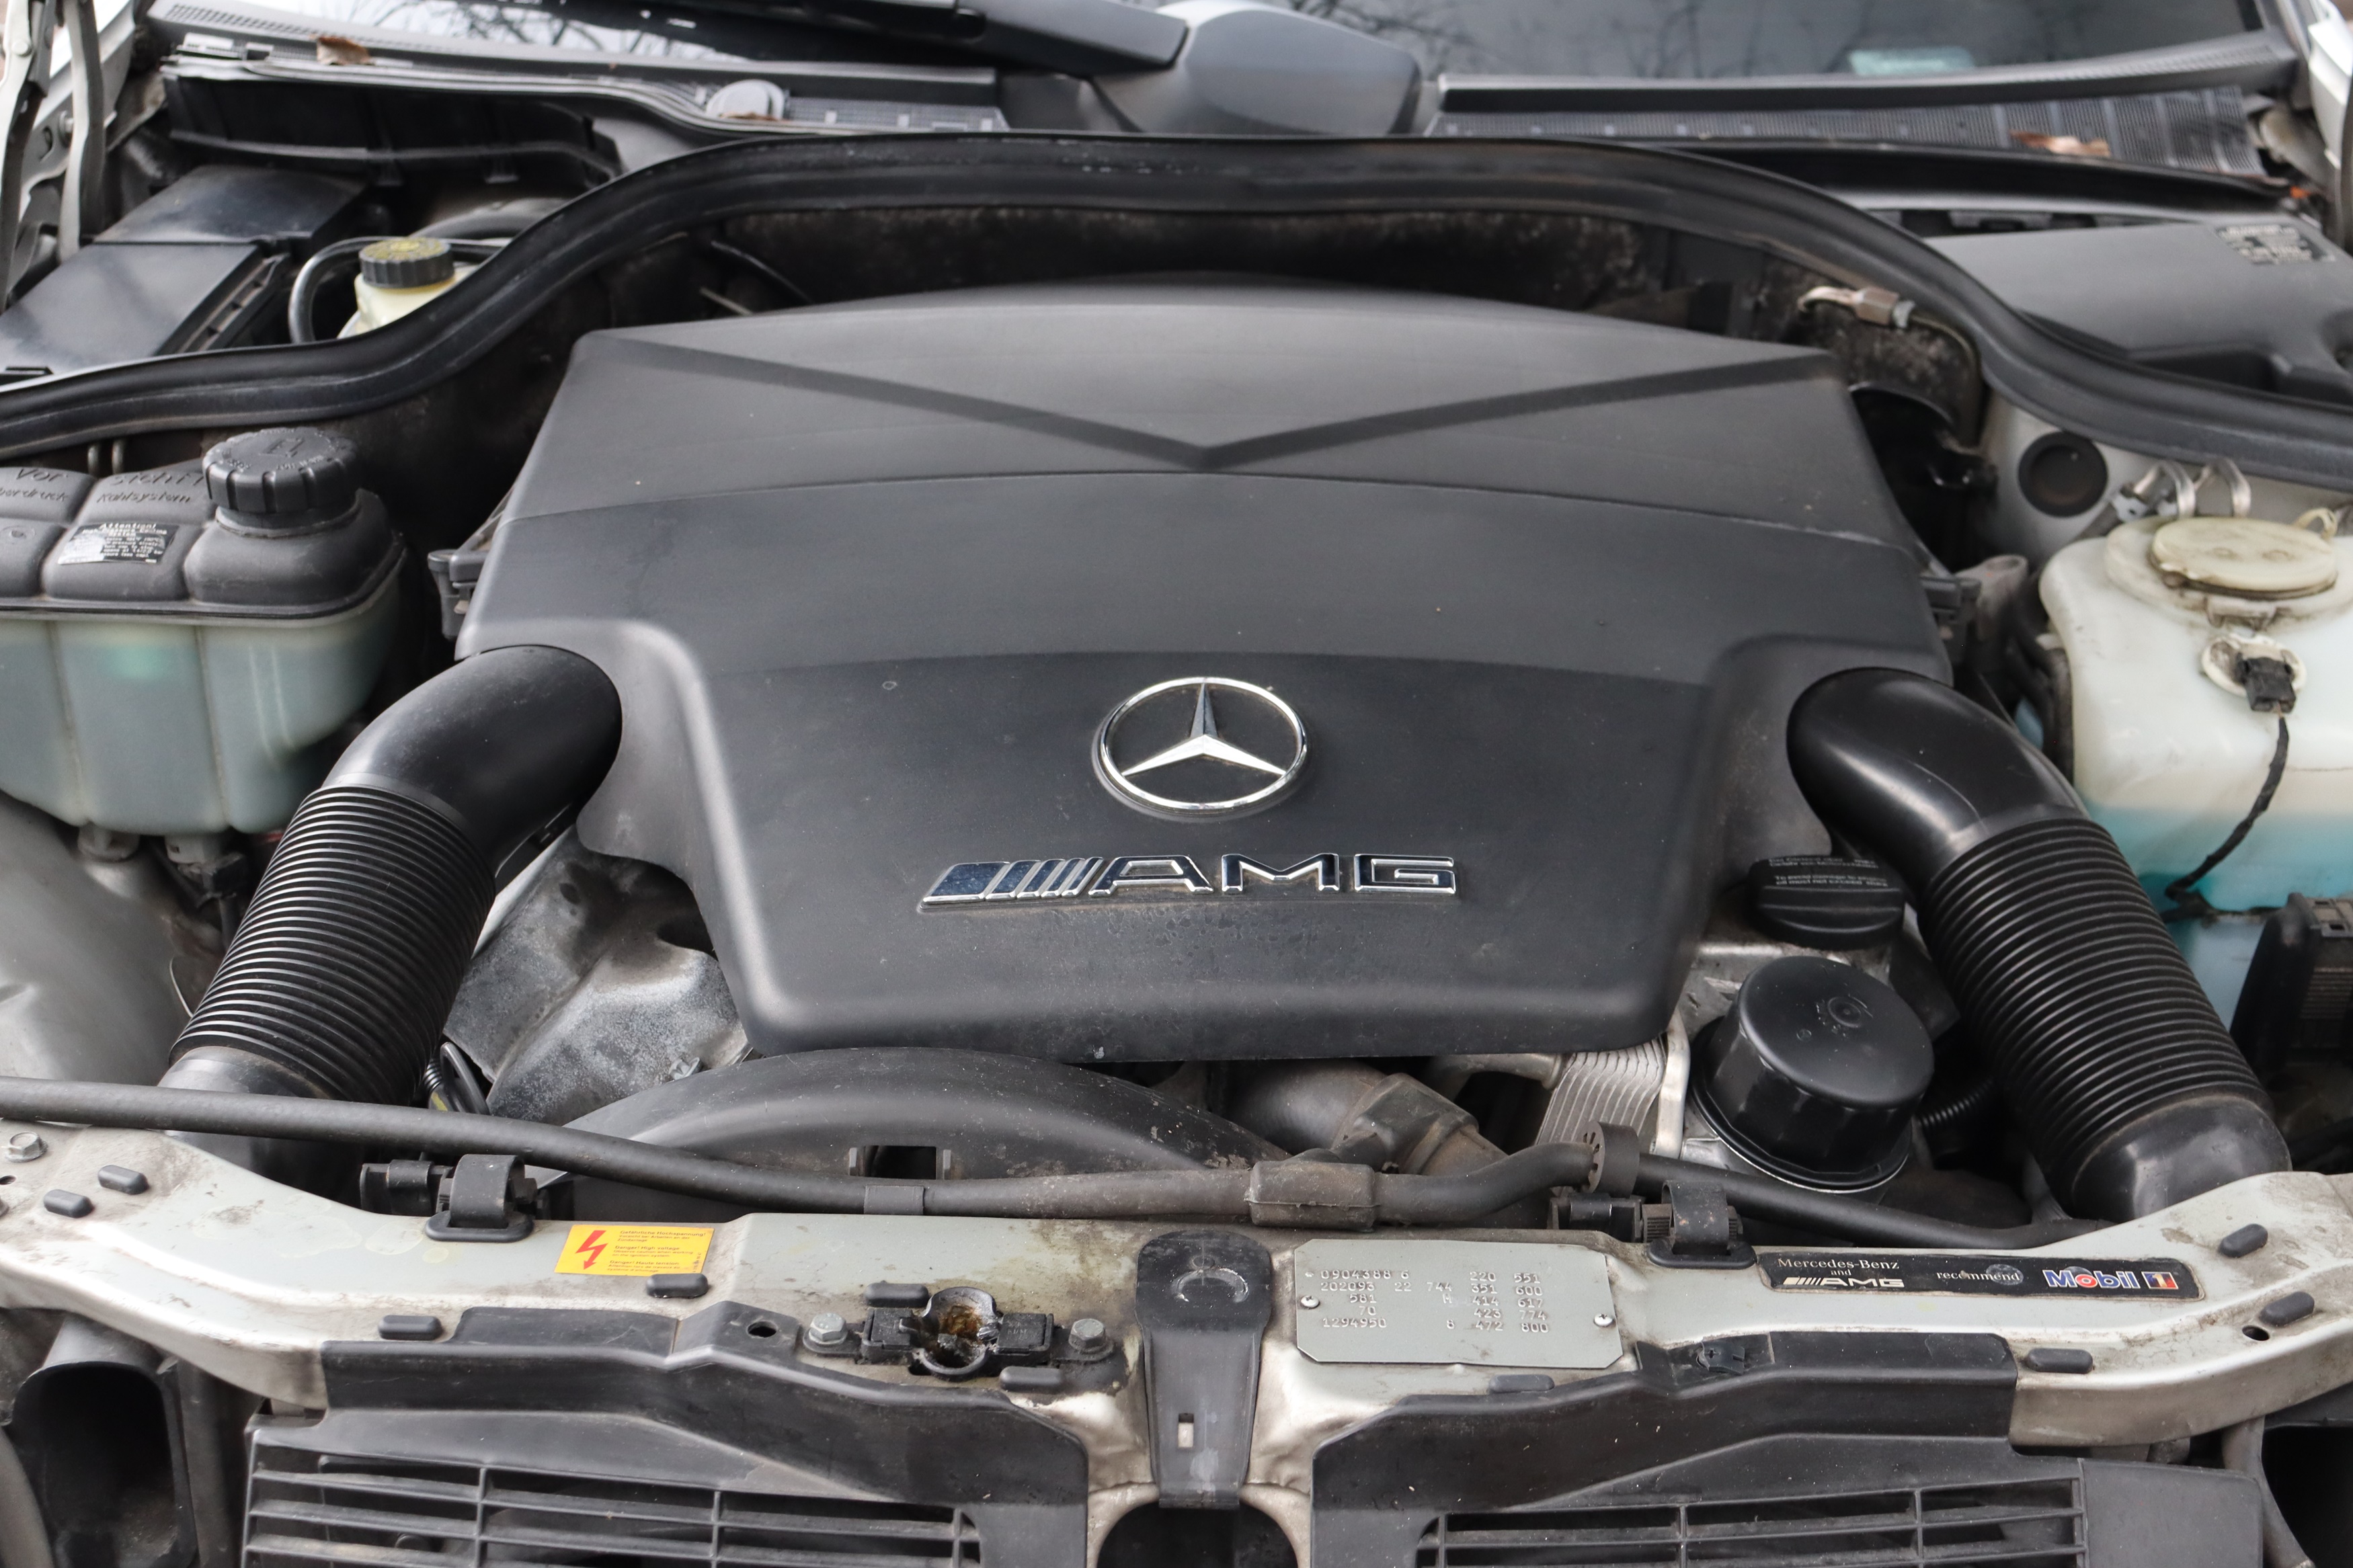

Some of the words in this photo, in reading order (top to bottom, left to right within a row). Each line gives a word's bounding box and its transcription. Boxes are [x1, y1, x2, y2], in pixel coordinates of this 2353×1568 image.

[1087, 852, 1458, 897] AMG
[1778, 1259, 1900, 1270] Mercedes-Benz
[1320, 1270, 1392, 1279] 0904388
[1470, 1271, 1497, 1282] 220
[1514, 1273, 1541, 1284] 551
[2042, 1270, 2141, 1289] Mobil
[1320, 1282, 1375, 1291] 202093
[1394, 1282, 1412, 1292] 22
[1427, 1282, 1452, 1292] 744
[1820, 1277, 1905, 1288] AMG
[1471, 1283, 1498, 1294] 351
[1516, 1285, 1543, 1296] 600
[1349, 1293, 1377, 1303] 581
[1472, 1296, 1499, 1307] 414
[1517, 1298, 1544, 1308] 617
[1359, 1306, 1377, 1315] 70
[1474, 1308, 1501, 1319] 423
[1519, 1310, 1546, 1321] 774
[1322, 1317, 1388, 1328] 1294950
[1475, 1320, 1503, 1331] 472
[1521, 1322, 1549, 1333] 800
